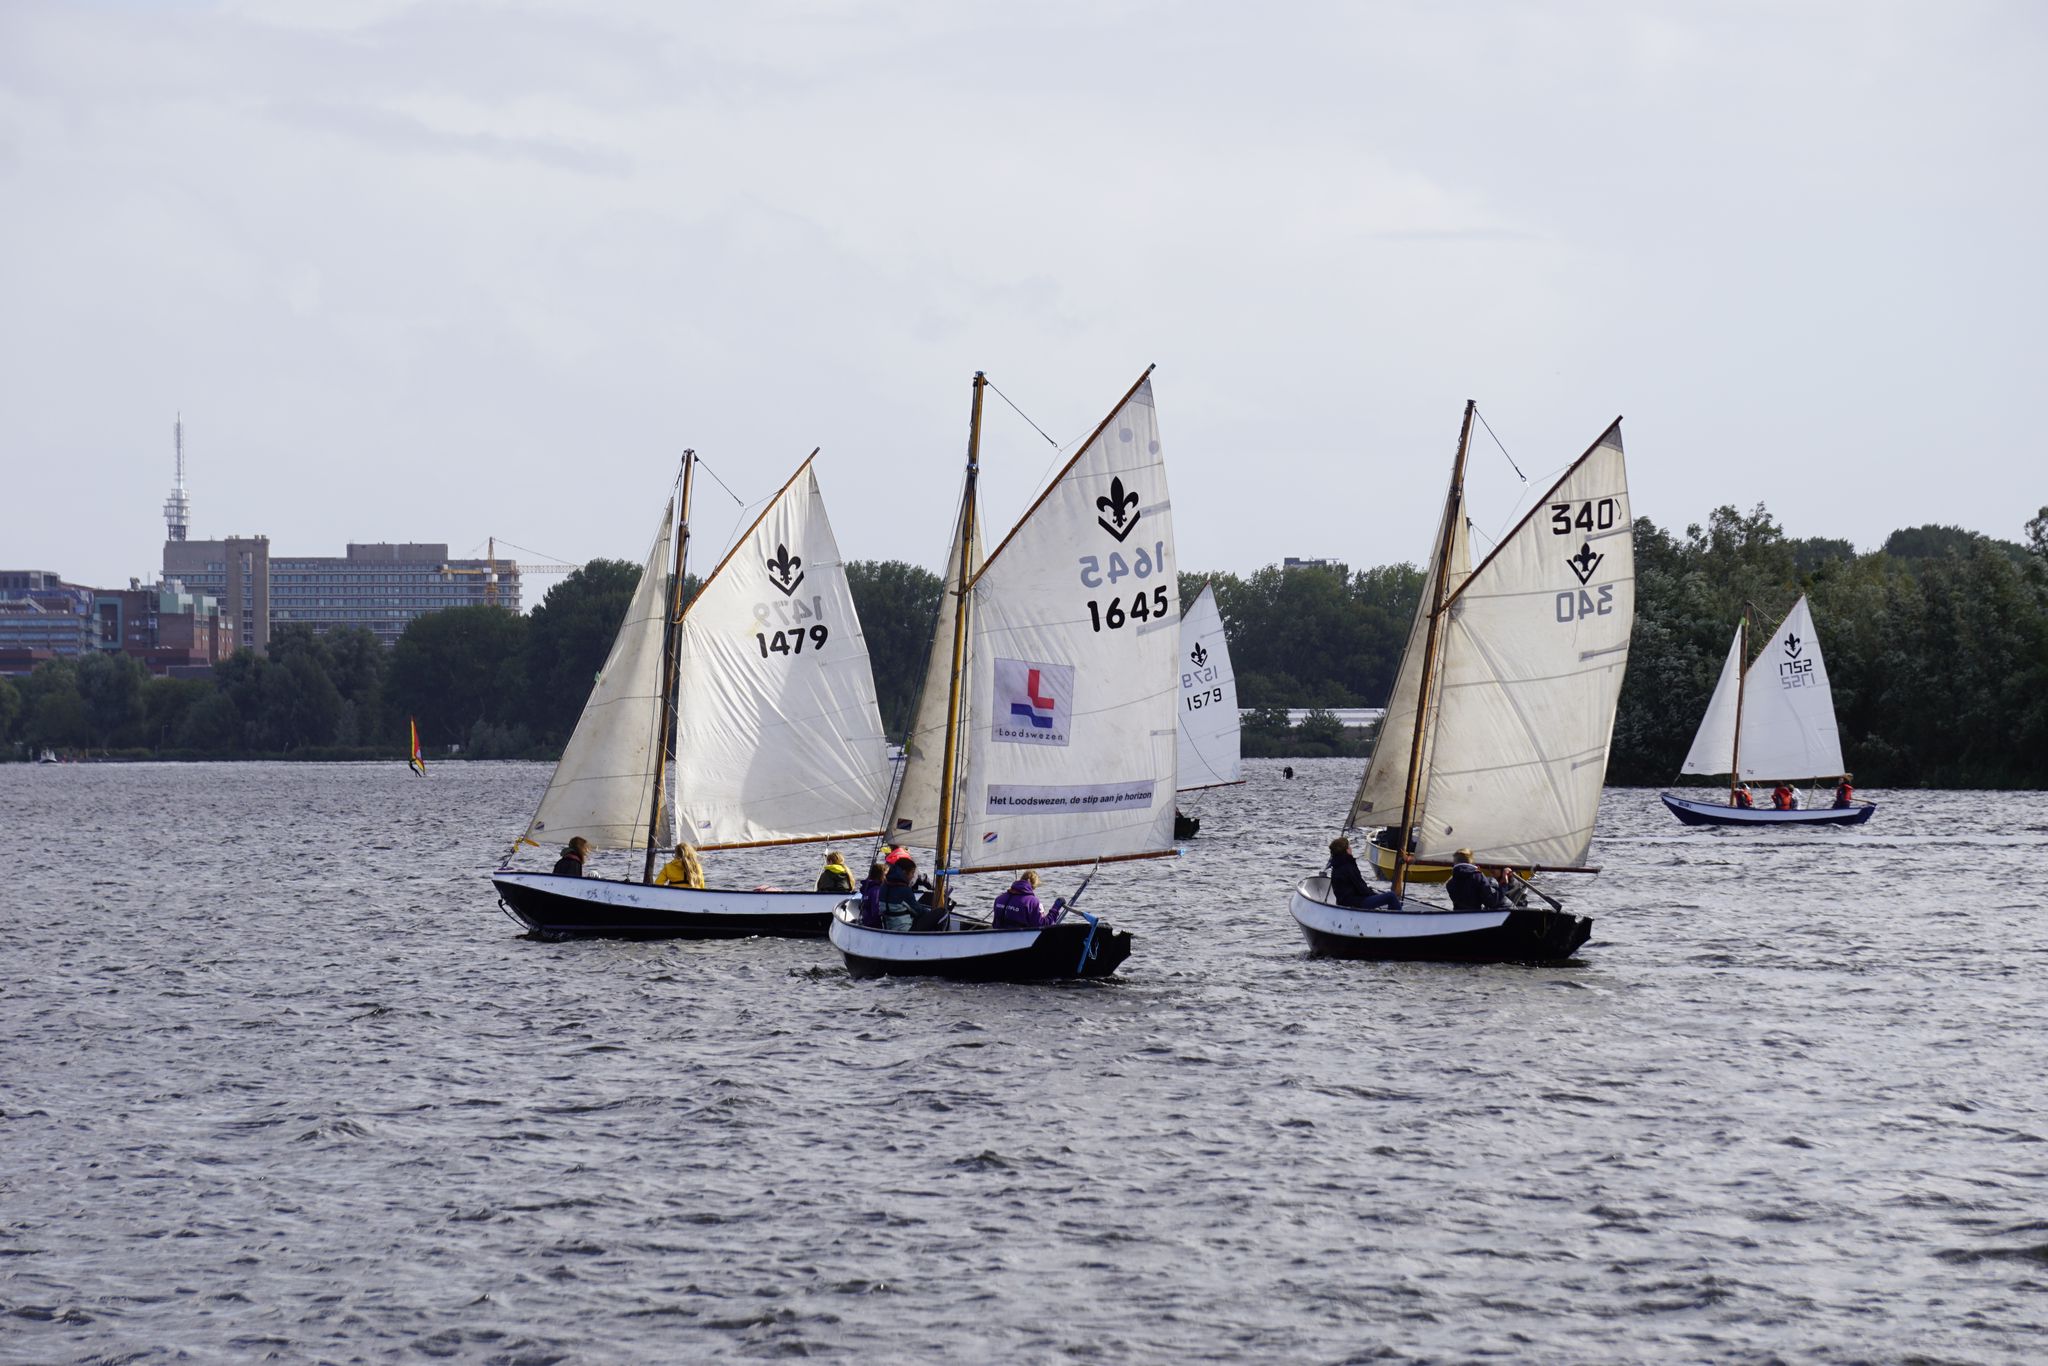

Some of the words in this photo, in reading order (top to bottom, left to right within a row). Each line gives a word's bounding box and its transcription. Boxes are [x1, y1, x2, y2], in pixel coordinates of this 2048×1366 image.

[1551, 498, 1613, 535] 340
[1087, 585, 1168, 632] 1645
[756, 625, 828, 658] 1479
[1780, 659, 1812, 676] 1752
[1187, 688, 1222, 711] 1579
[990, 796, 1007, 805] Het
[1009, 796, 1068, 806] Loodswezen,
[1070, 796, 1081, 804] de
[1083, 794, 1099, 805] stip
[1100, 795, 1114, 803] aan
[1115, 793, 1124, 803] je
[1125, 792, 1152, 801] horizon
